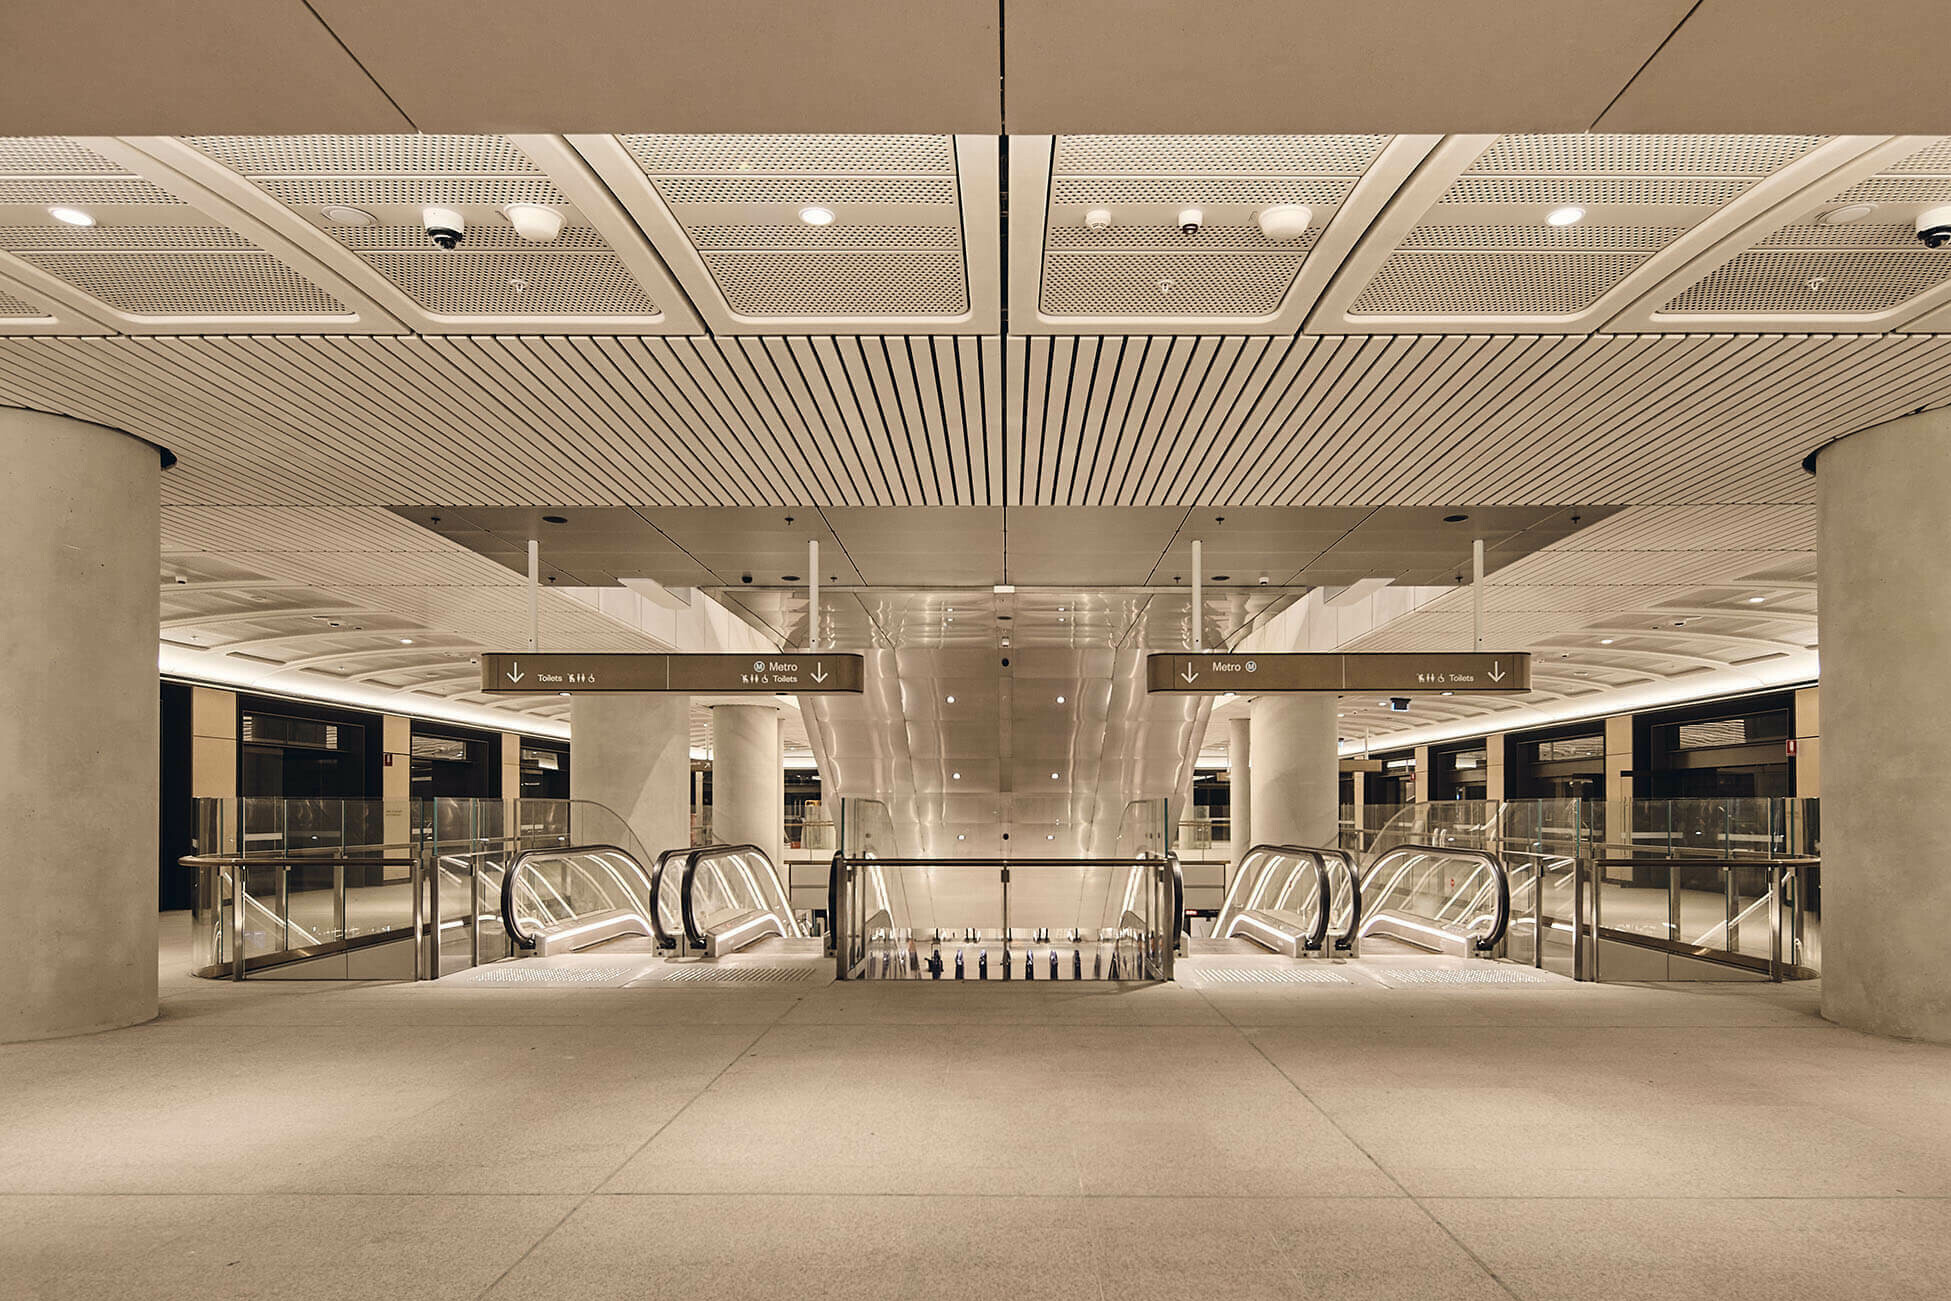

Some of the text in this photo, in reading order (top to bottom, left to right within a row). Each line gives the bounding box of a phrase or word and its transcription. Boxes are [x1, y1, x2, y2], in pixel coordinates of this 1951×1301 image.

[769, 662, 798, 671] Metro
[1212, 661, 1241, 671] Metro
[537, 674, 562, 682] Toilets
[772, 674, 798, 683] Toilets
[1449, 674, 1474, 682] Toilets
